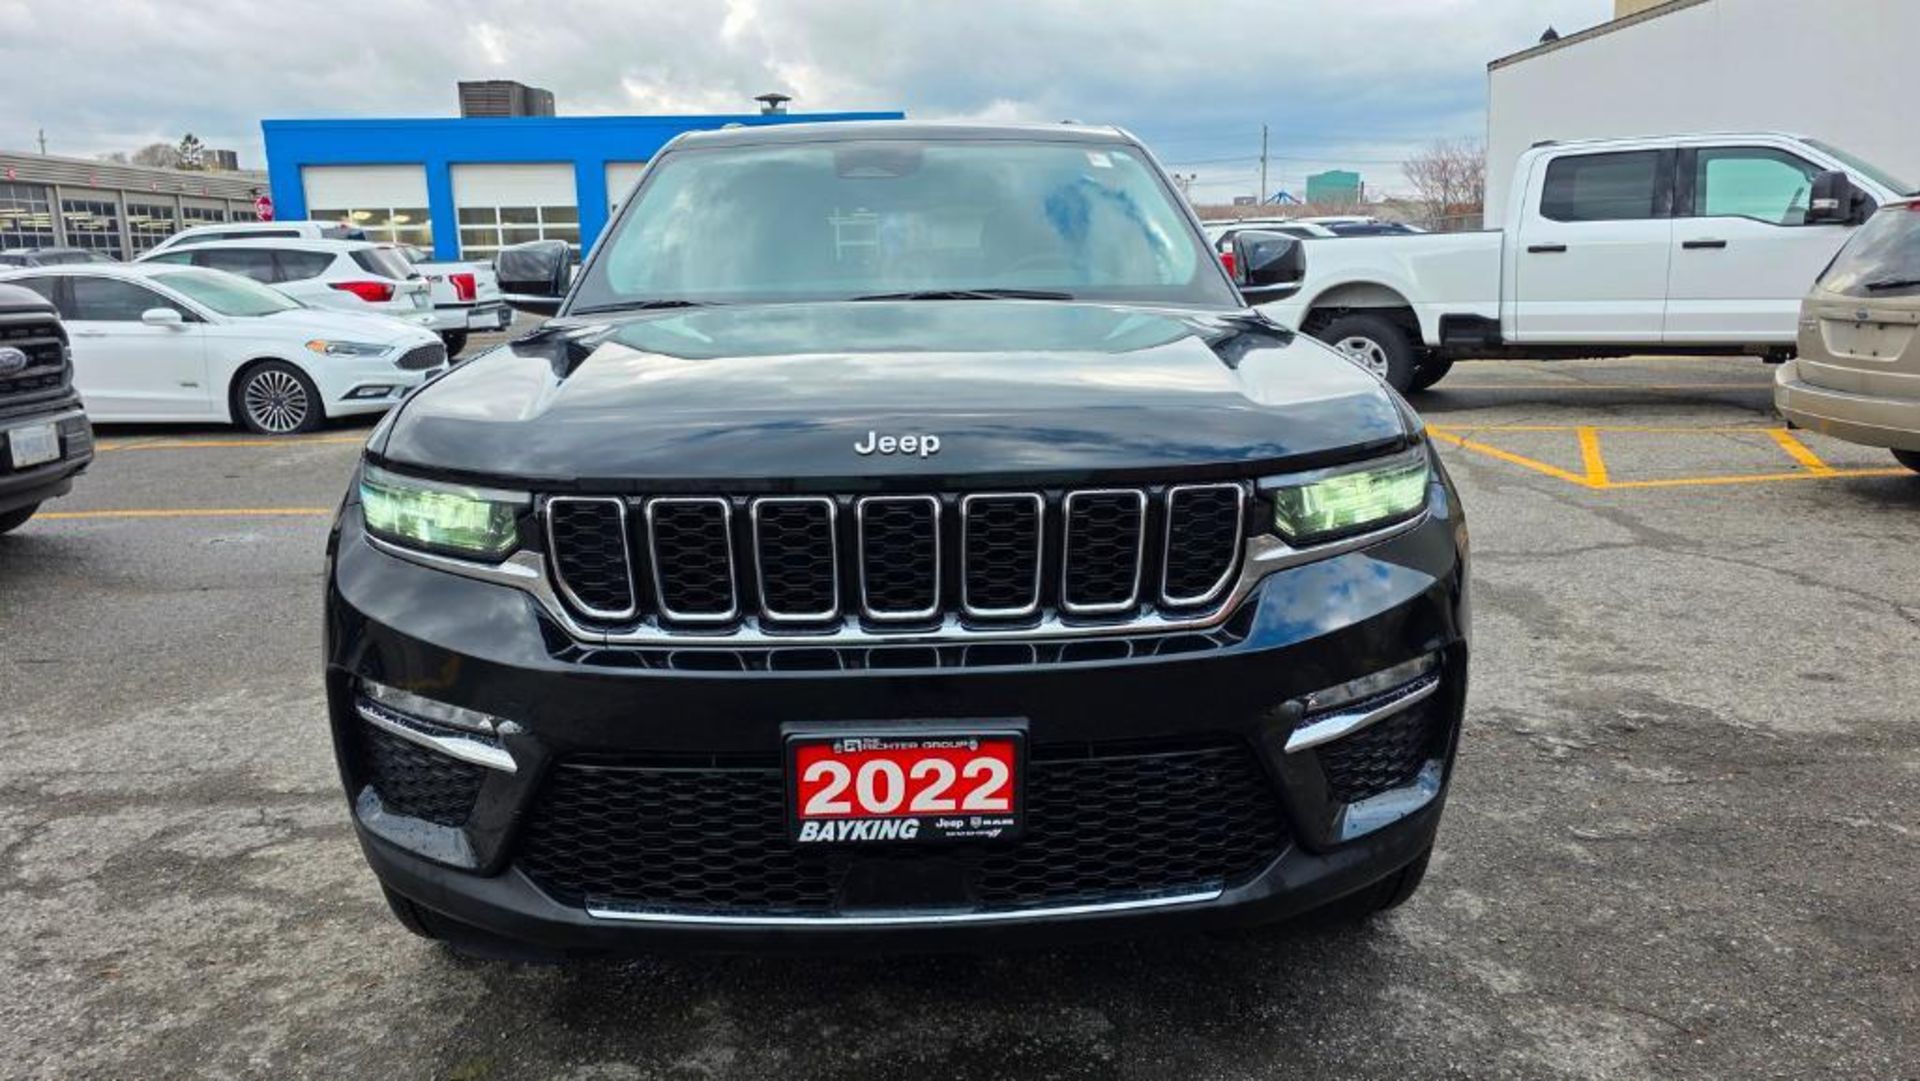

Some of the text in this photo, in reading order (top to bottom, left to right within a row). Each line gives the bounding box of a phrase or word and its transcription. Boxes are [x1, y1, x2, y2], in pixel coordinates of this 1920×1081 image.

[854, 430, 941, 457] Jeep
[922, 740, 968, 749] GROUP
[803, 757, 1009, 815] 2022
[799, 818, 920, 843] BAYKING
[935, 818, 964, 829] Jeep
